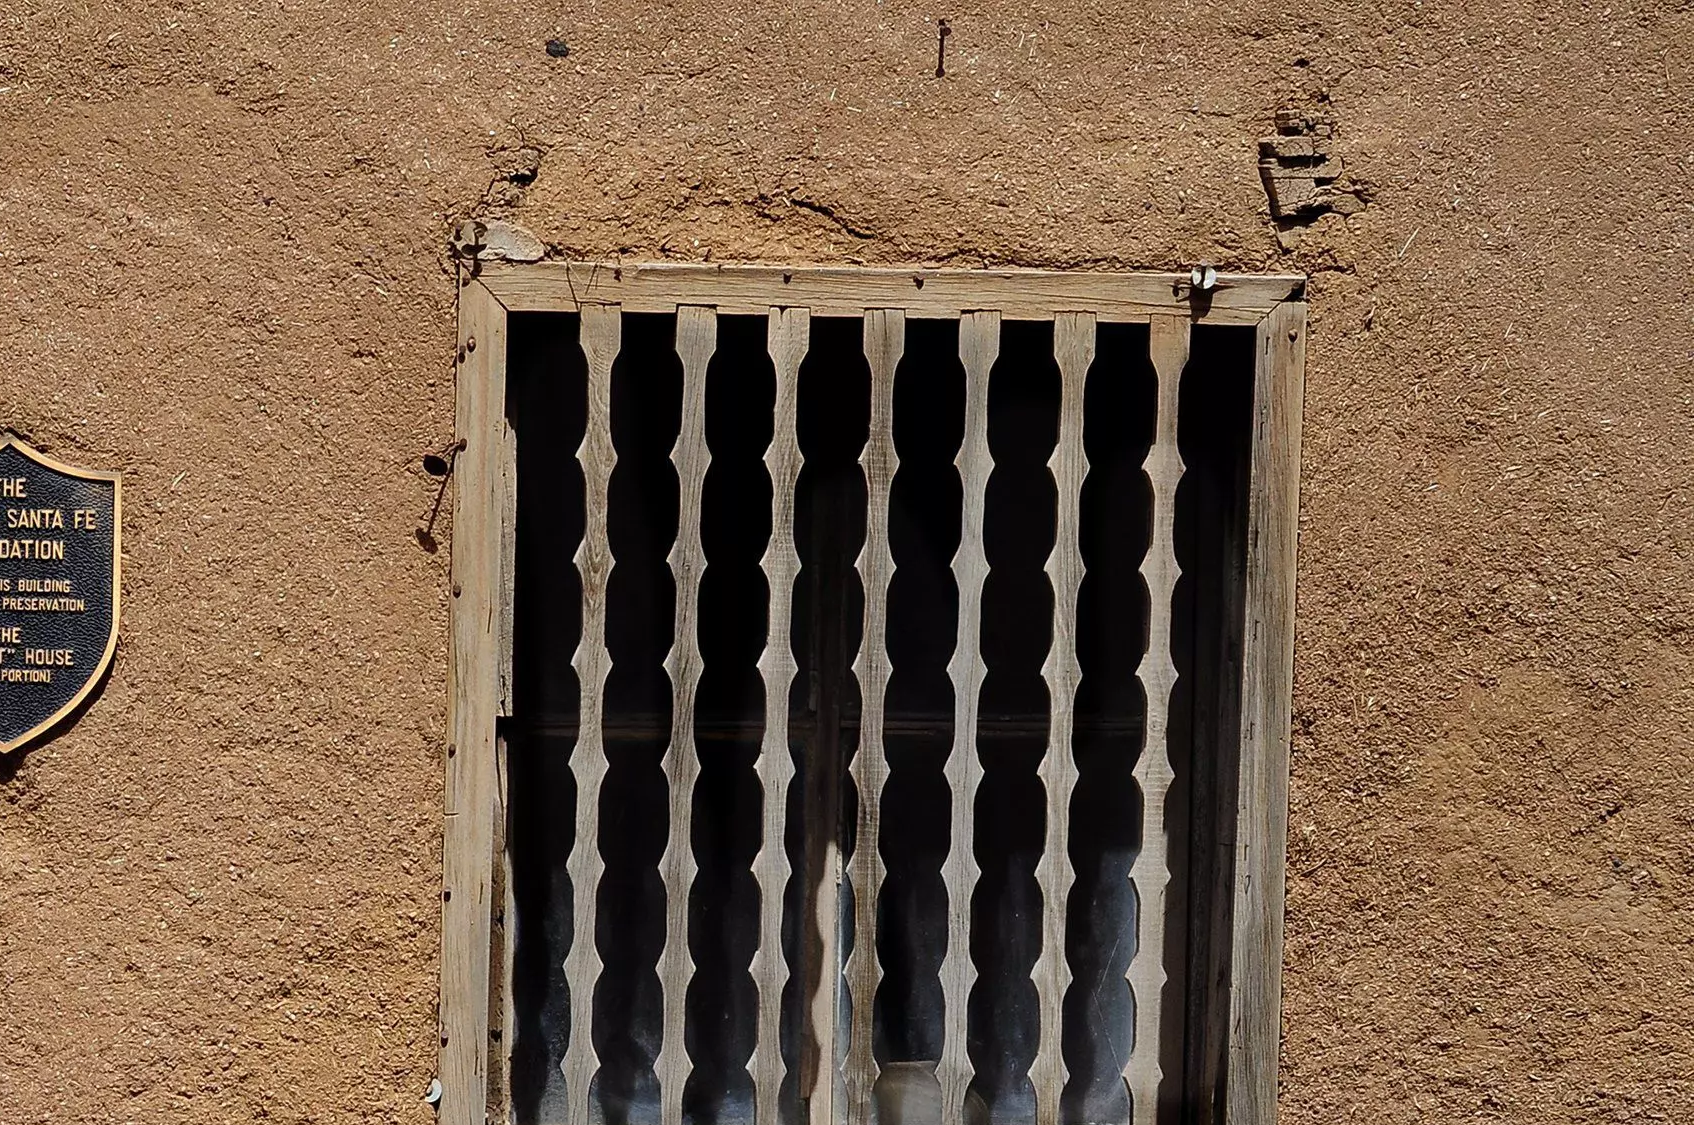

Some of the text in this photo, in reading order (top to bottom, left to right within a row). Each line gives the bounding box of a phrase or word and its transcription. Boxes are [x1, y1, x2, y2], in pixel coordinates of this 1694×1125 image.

[8, 509, 62, 528] SANTA
[75, 510, 96, 529] FE
[18, 580, 70, 592] BUILDING
[3, 598, 84, 611] PRESERVATION
[26, 649, 74, 666] HOUSE
